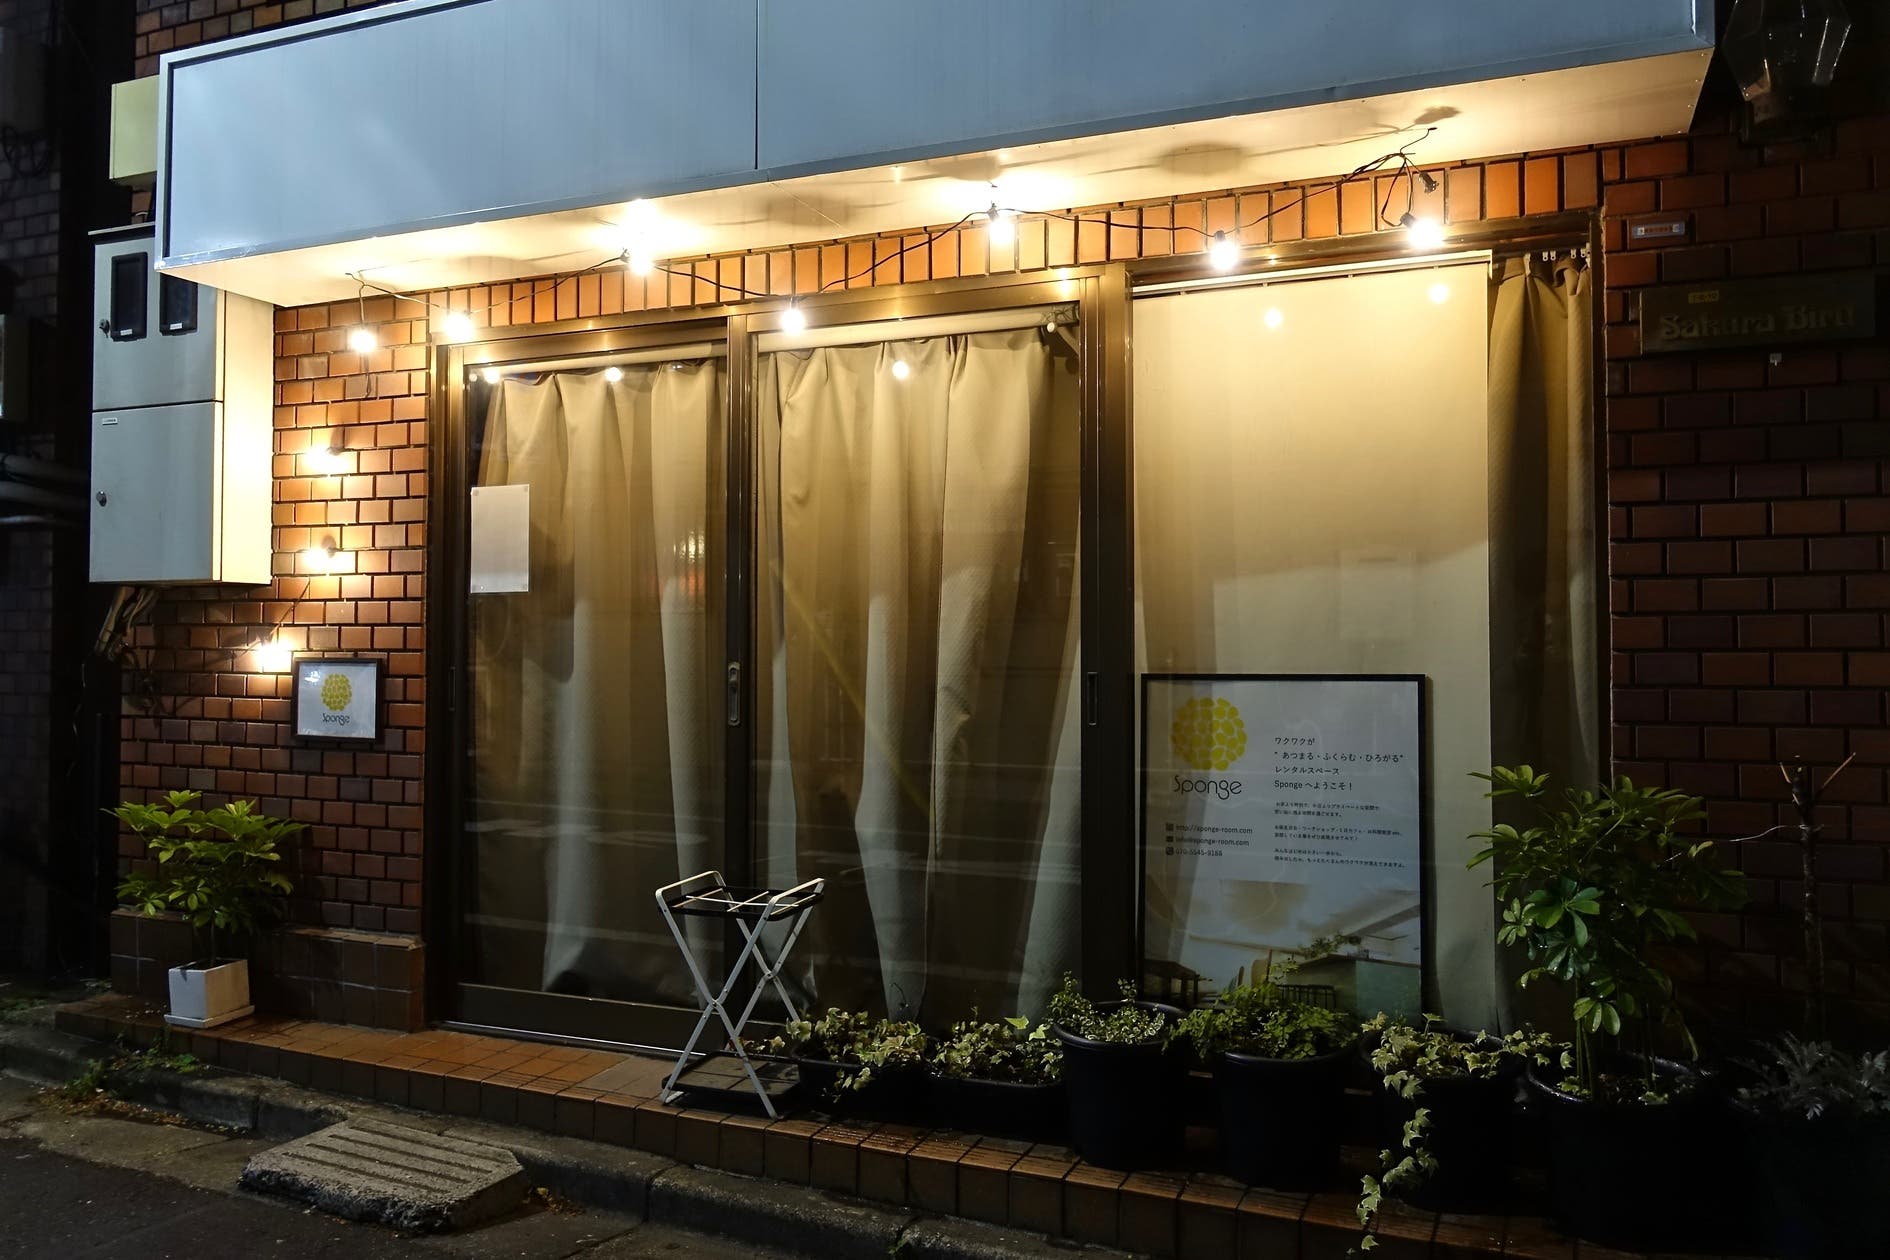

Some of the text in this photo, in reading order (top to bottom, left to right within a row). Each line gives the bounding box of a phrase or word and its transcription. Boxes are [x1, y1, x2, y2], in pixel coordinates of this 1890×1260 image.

[1661, 313, 1775, 340] Sakura
[321, 713, 351, 726] Sponge
[1274, 737, 1315, 746] ワクワクが
[1275, 766, 1340, 775] レンタルスペース
[1173, 774, 1242, 801] Sponge
[1176, 836, 1250, 846] sponge-room.com
